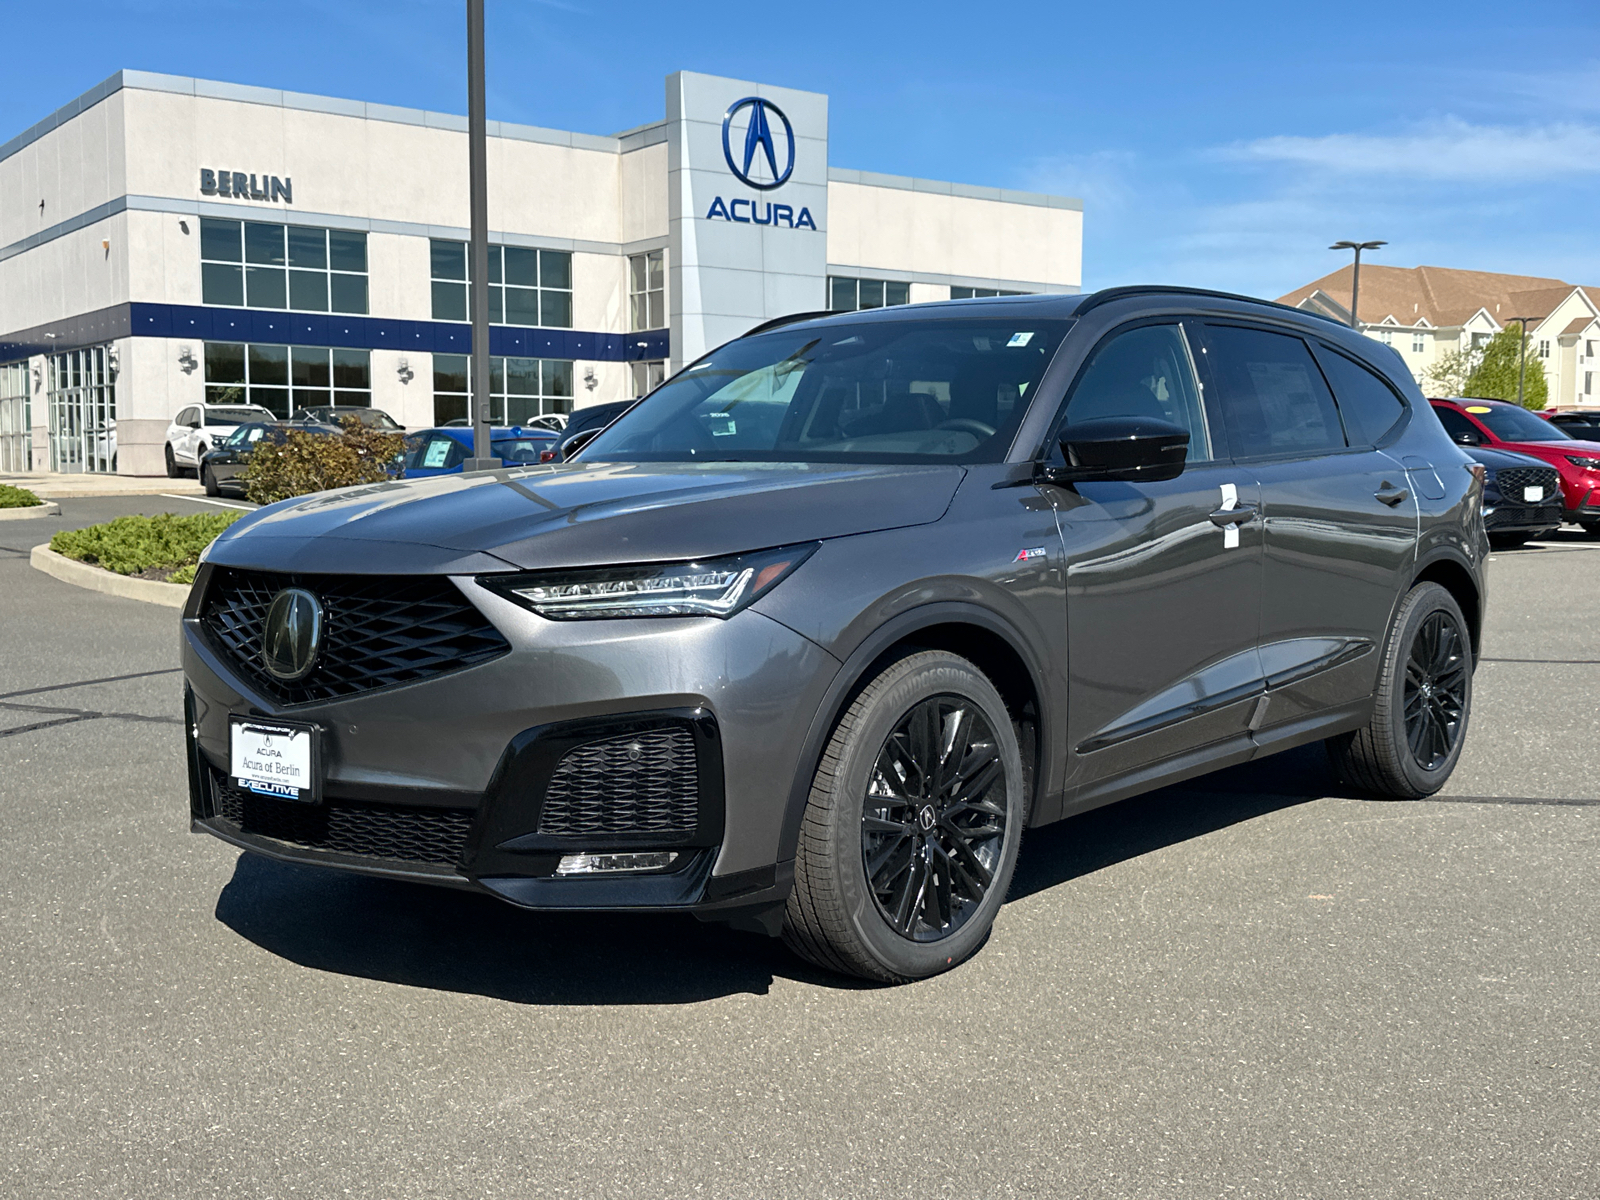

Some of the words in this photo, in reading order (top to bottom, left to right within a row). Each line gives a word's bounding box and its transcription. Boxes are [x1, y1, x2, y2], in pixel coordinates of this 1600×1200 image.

[200, 168, 292, 203] BERLIN
[706, 196, 817, 231] ACURA
[256, 748, 282, 758] ACURA
[242, 757, 263, 771] Acura
[265, 761, 273, 773] of
[275, 762, 300, 777] Berlin
[238, 778, 299, 796] EXECUTIVE
